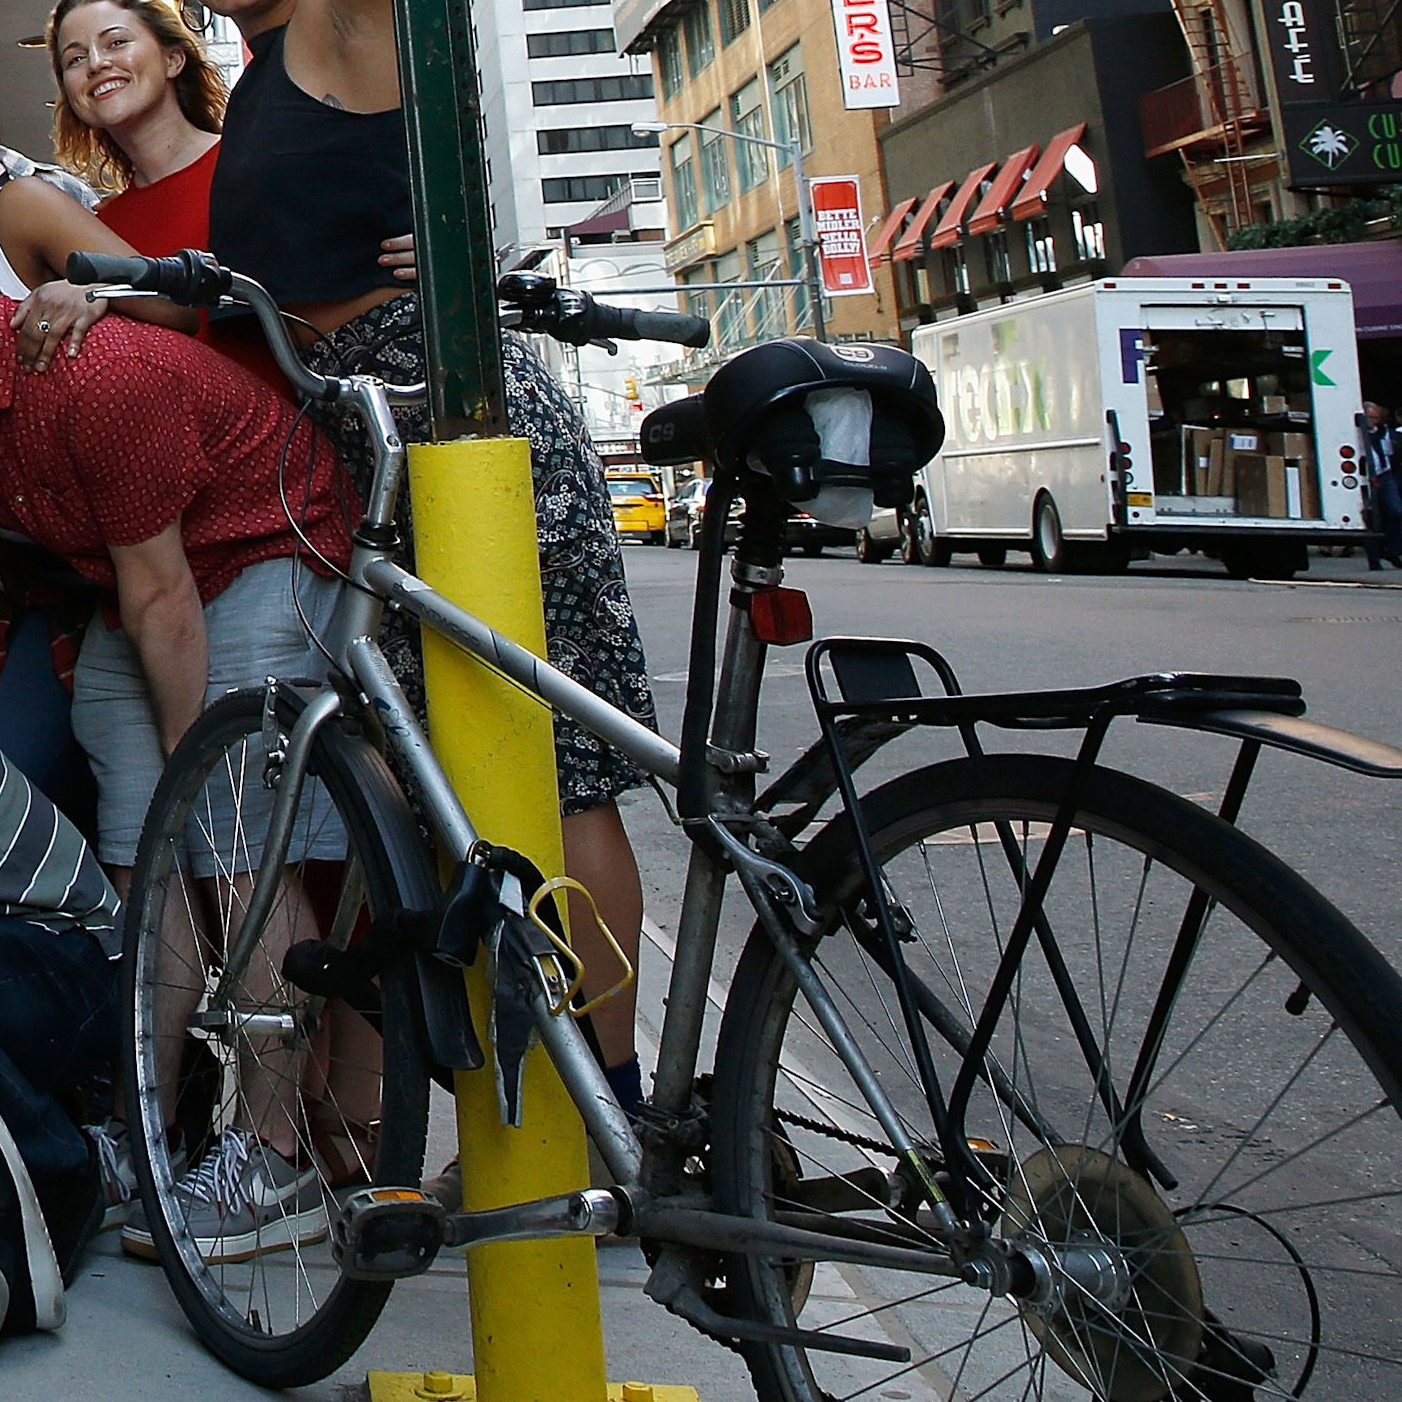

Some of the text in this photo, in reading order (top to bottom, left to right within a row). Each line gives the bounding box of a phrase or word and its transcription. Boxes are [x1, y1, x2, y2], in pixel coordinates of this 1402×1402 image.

[848, 72, 892, 90] BAR
[817, 208, 857, 221] BETTE
[816, 219, 860, 231] MIDLER
